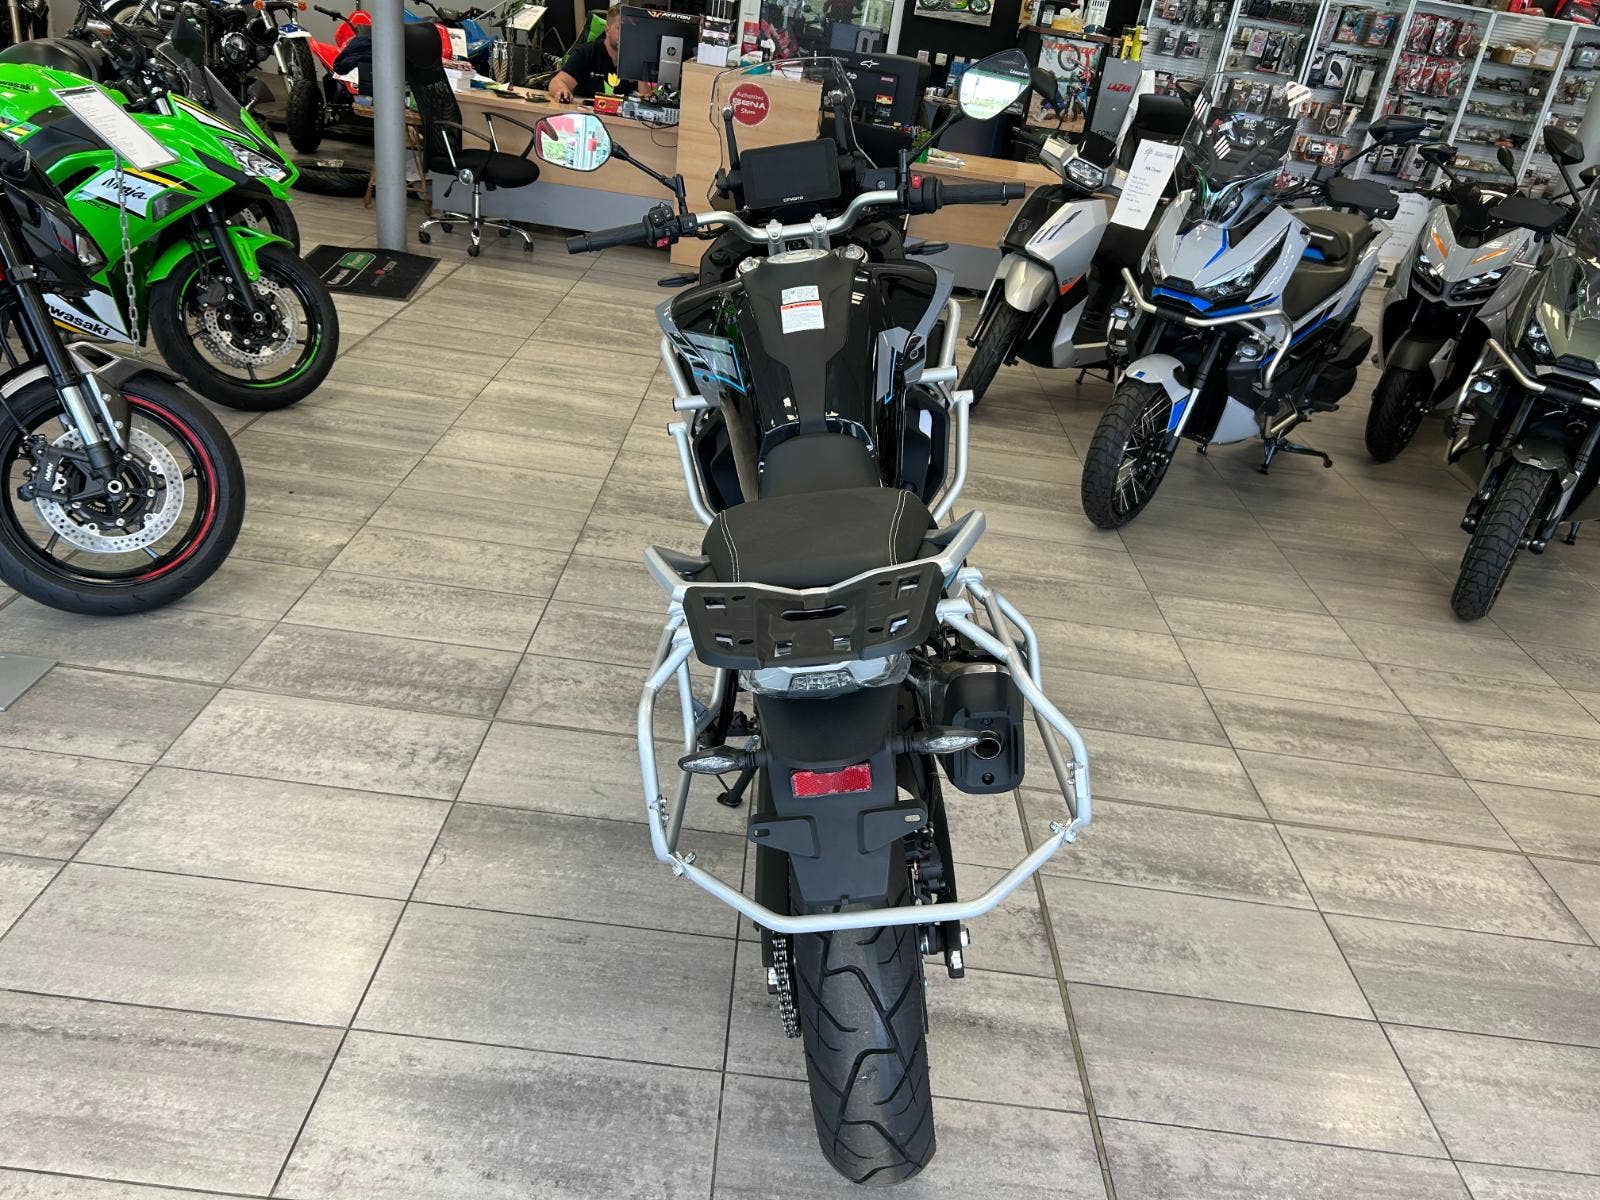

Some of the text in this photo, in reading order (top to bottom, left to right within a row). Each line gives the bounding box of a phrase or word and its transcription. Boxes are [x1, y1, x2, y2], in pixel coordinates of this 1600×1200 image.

[1107, 83, 1132, 93] LAZER
[732, 97, 766, 111] SENA
[101, 177, 148, 200] Ninja
[50, 305, 111, 337] wasaki
